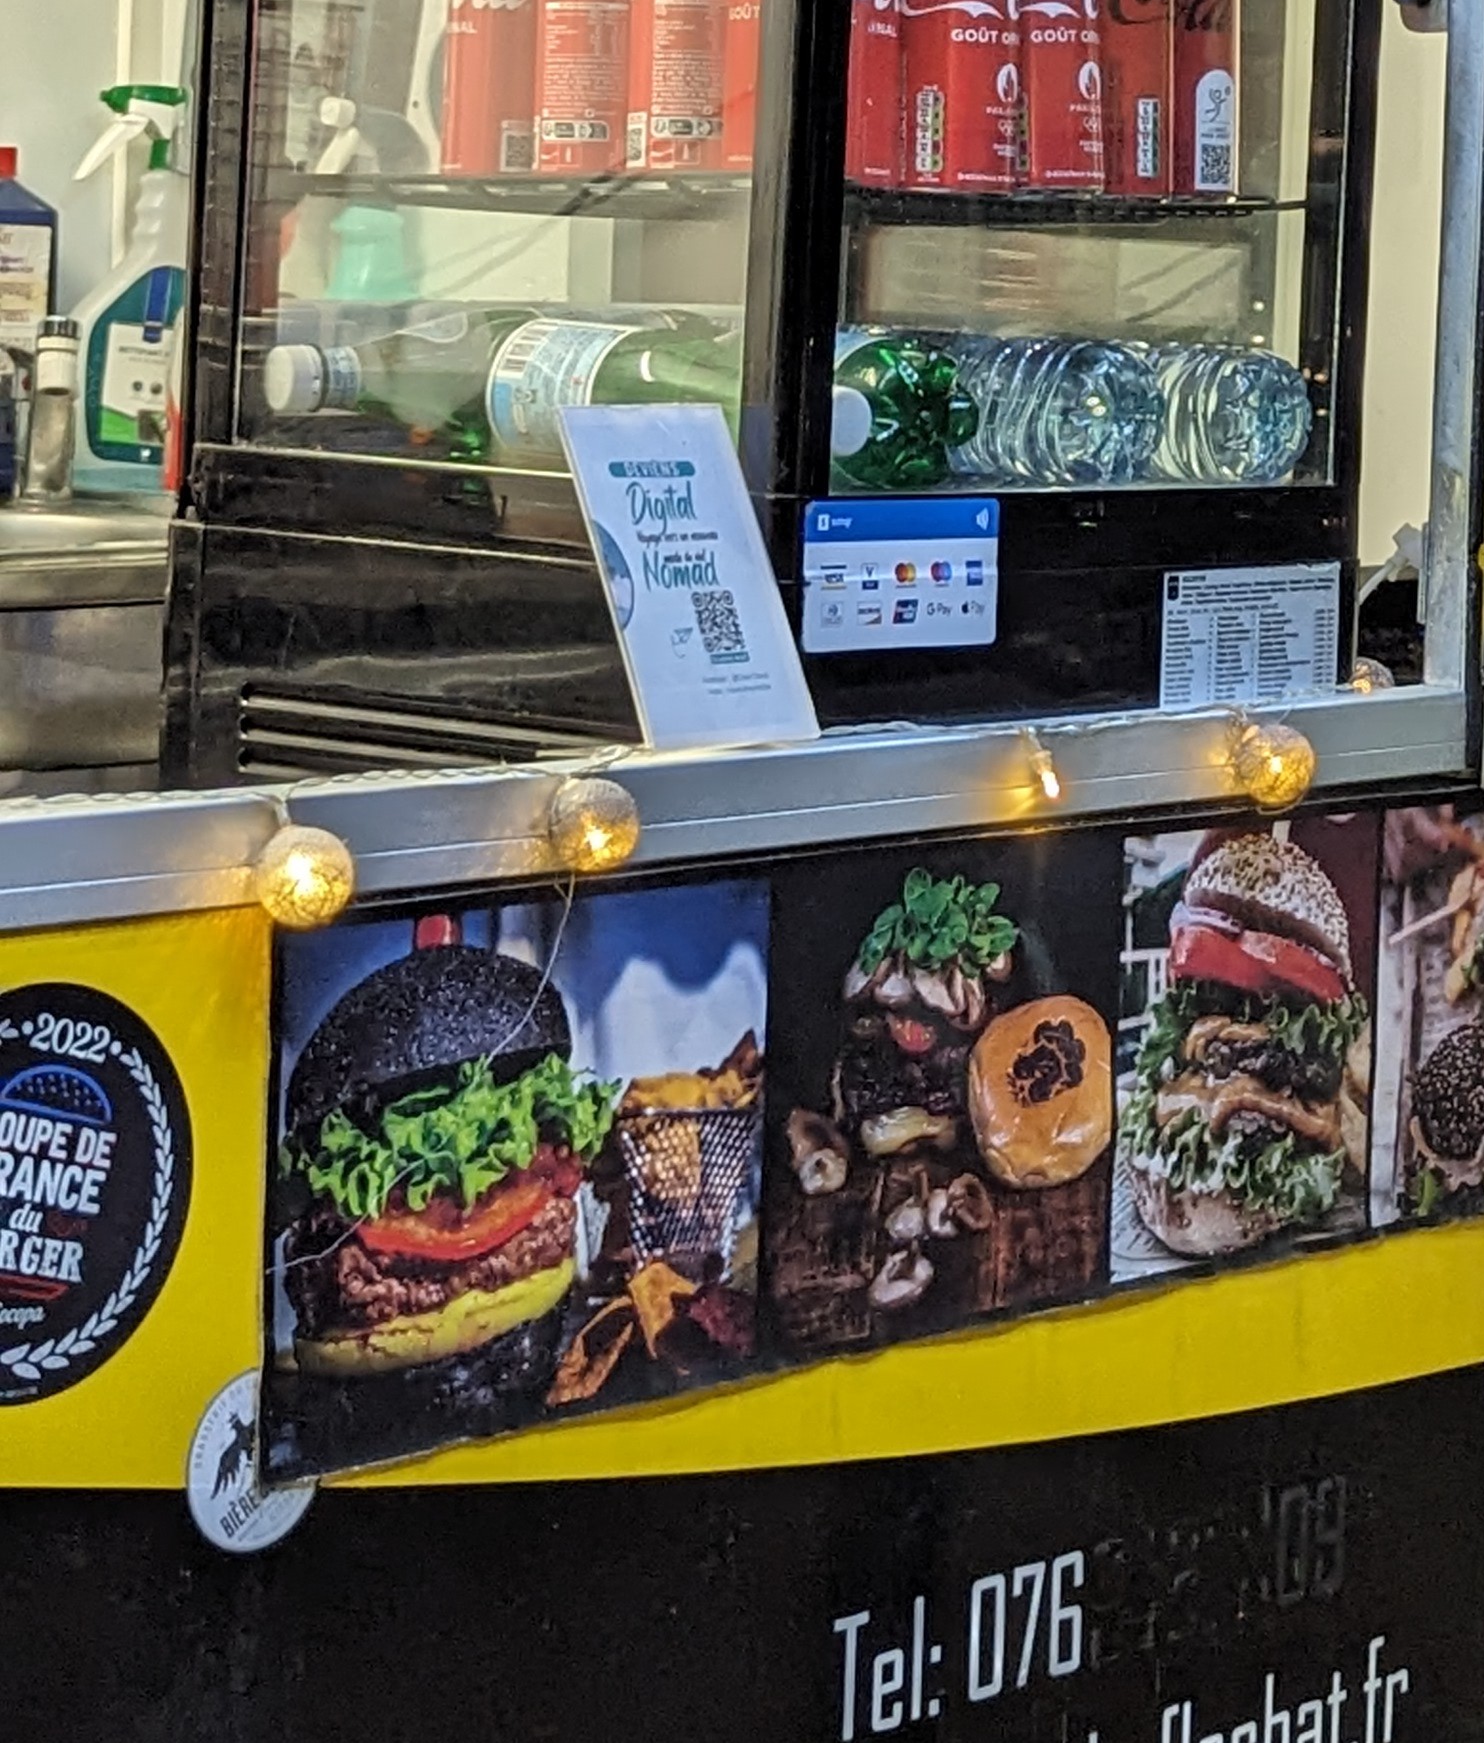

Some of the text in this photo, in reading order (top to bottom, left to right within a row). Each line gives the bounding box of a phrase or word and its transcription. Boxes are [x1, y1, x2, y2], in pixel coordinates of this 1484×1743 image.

[951, 27, 998, 44] GOÛT
[1030, 27, 1076, 44] GOÛT
[625, 480, 698, 537] Digital
[642, 549, 720, 593] Nomad
[30, 1011, 112, 1064] 2022
[77, 1123, 118, 1170] DE
[10, 1201, 44, 1235] du
[832, 1595, 943, 1742] Tel:
[966, 1549, 1086, 1704] 076
